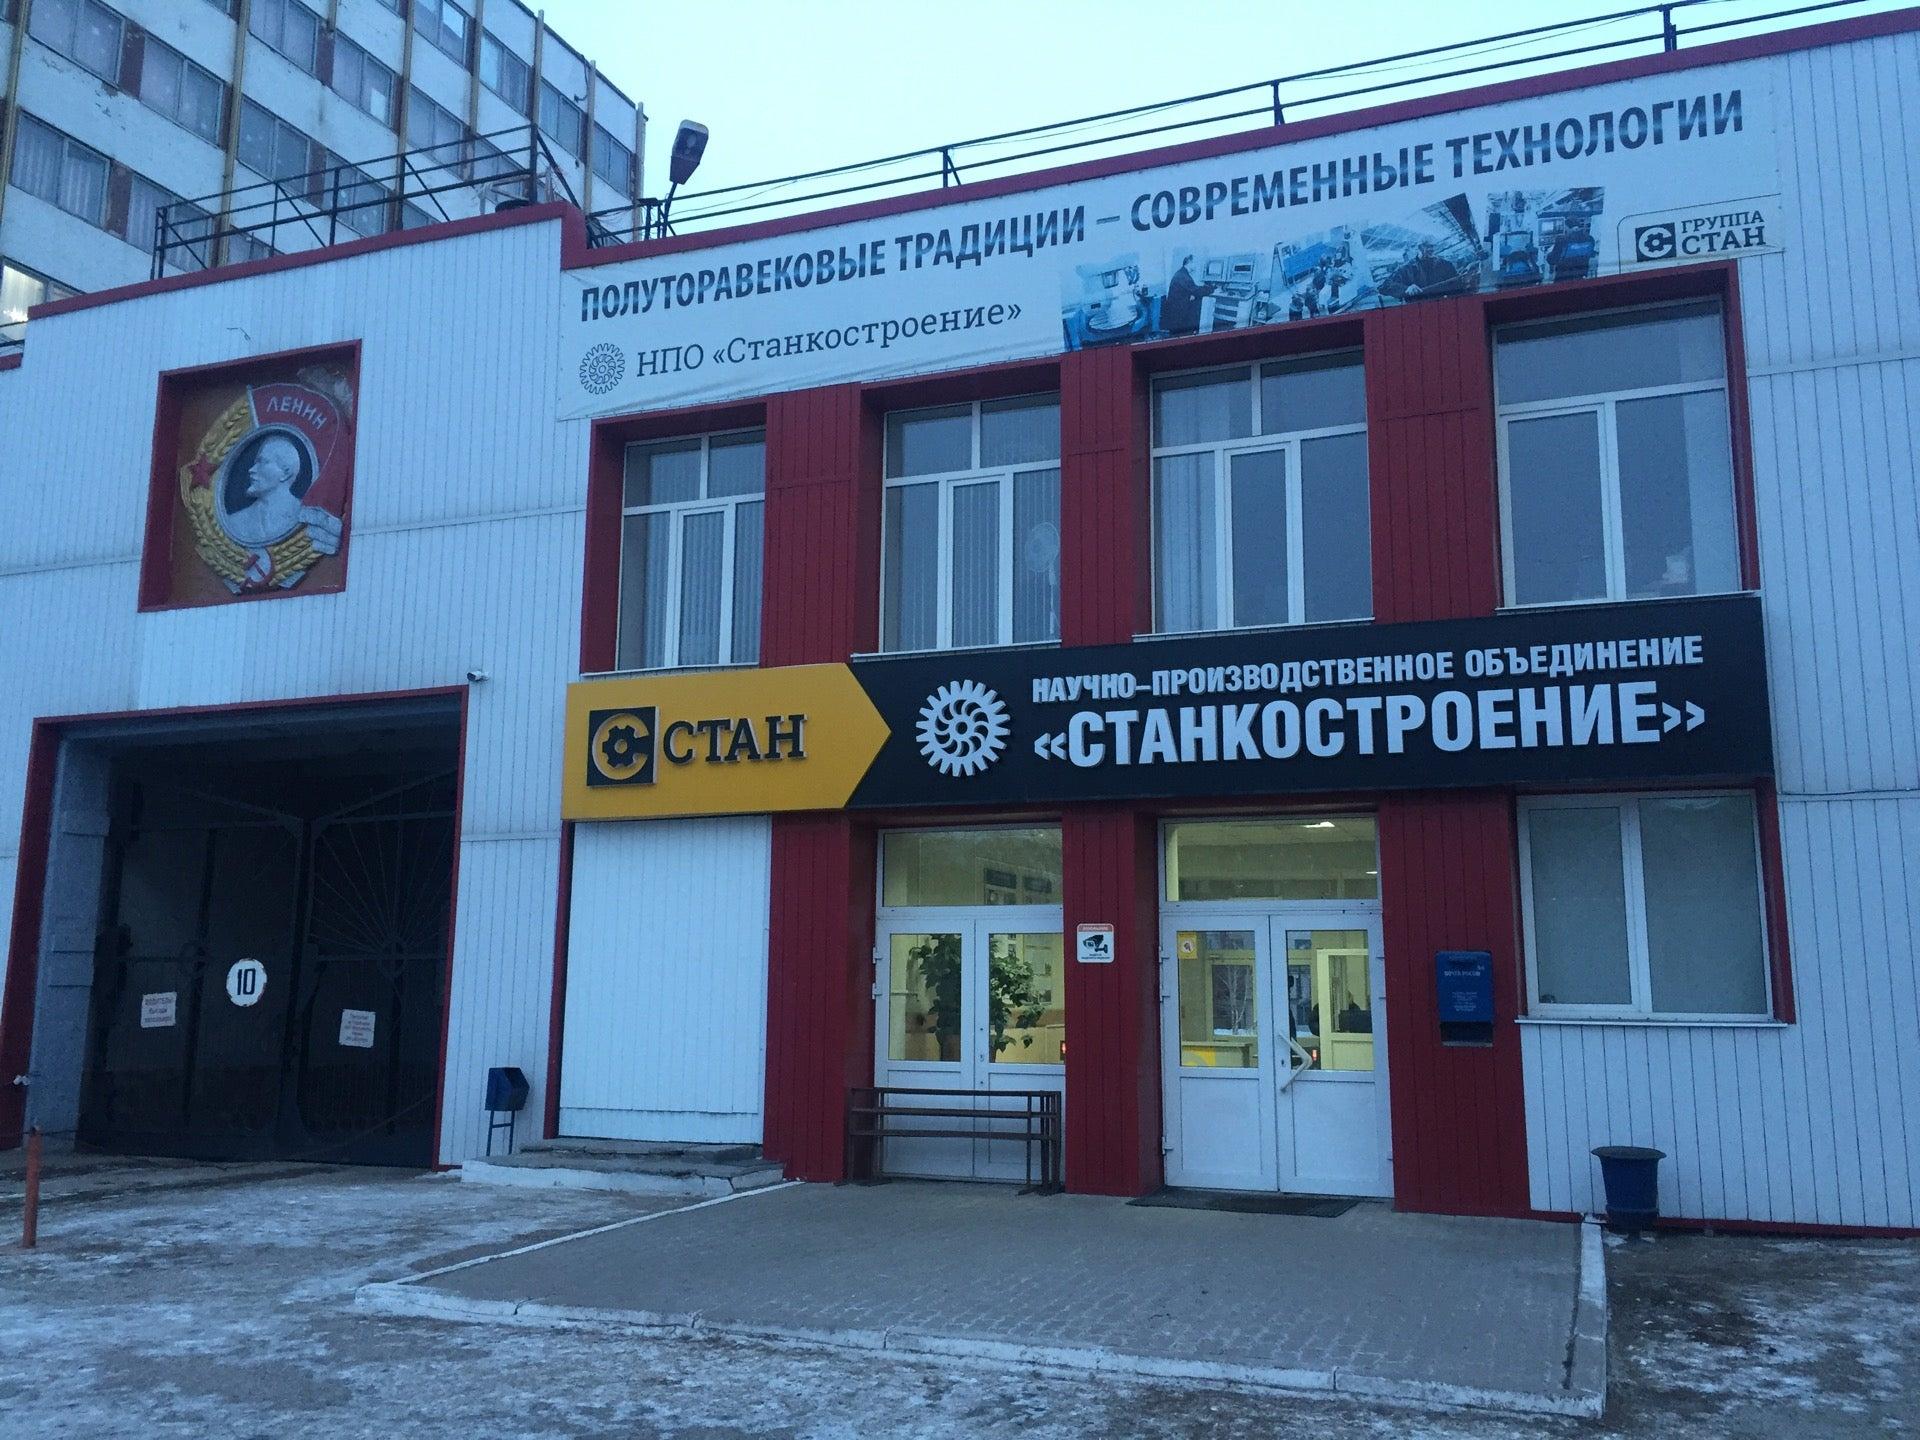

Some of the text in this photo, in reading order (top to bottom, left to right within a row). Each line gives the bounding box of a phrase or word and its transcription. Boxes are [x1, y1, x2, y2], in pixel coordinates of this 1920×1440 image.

[581, 240, 885, 321] ПОЛУТОРАВЕКОВЫЕ
[896, 206, 1084, 269] ТРАДИЦИИ
[1131, 144, 1434, 232] СОВРЕМЕННЫЕ
[1447, 90, 1742, 178] ТЕХНОЛОГИИ
[1681, 210, 1764, 232] ГРУППА
[1681, 225, 1766, 255] СТАН
[637, 303, 1021, 377] НПО «Станкостроение»
[267, 396, 327, 430] ЛЕНИН
[1032, 635, 1703, 703] НАУЧНО-ПРОИЗВОДСТВЕННОЕ ОБЪЕДИНЕНИЕ
[662, 714, 808, 765] СТАН
[237, 968, 256, 996] 10
